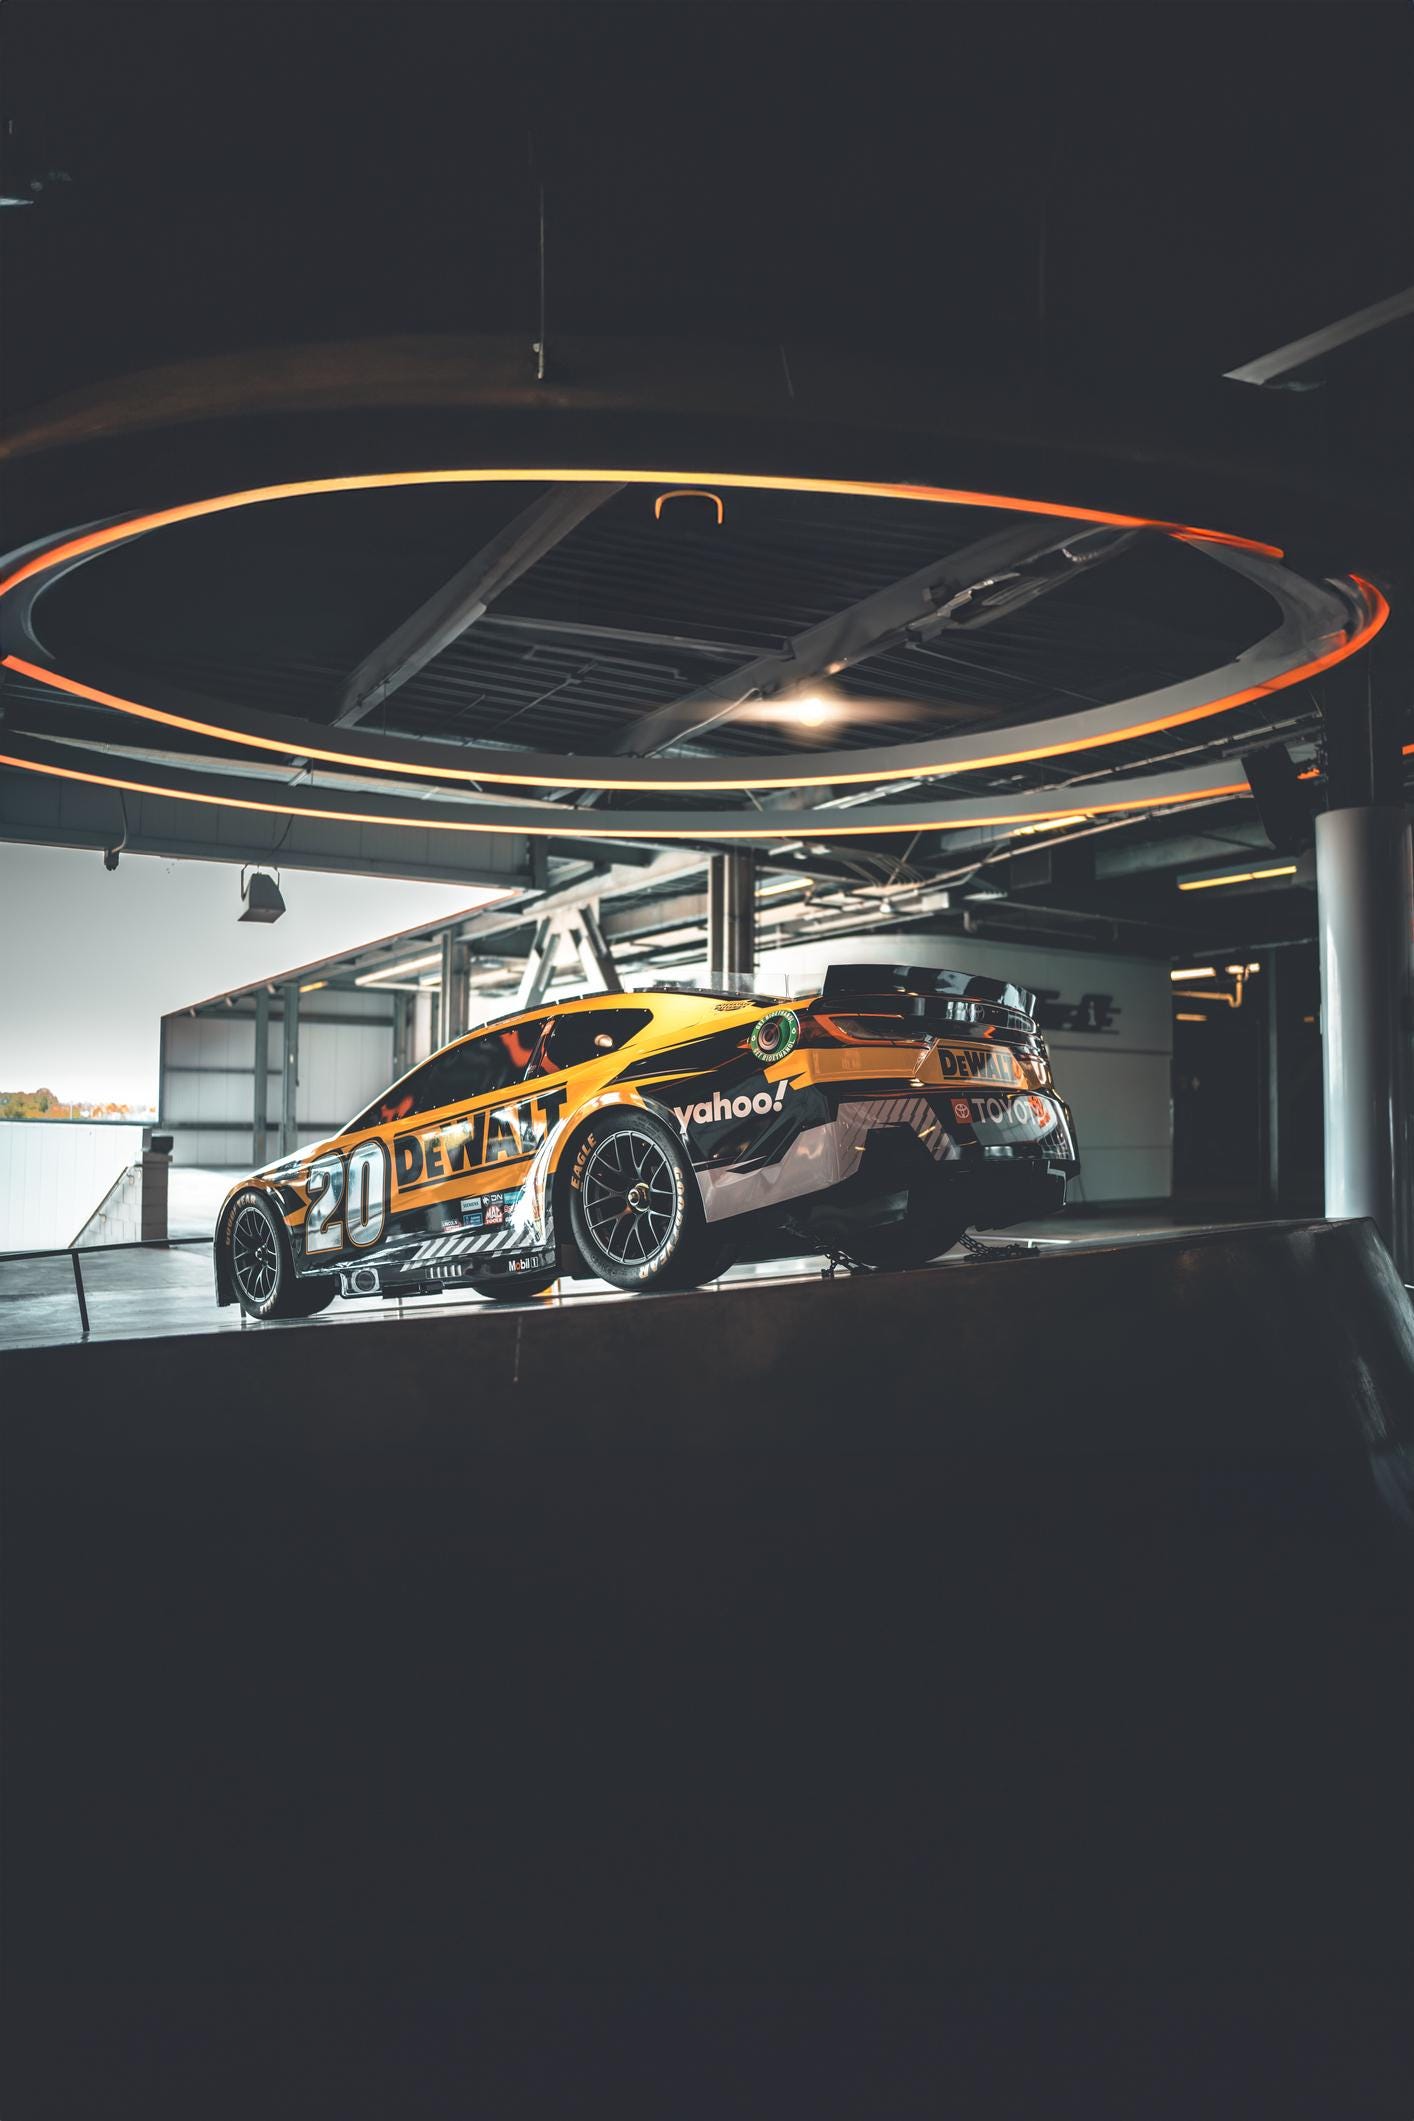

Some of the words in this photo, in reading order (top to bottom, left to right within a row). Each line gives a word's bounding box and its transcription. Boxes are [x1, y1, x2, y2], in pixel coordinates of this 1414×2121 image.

[674, 1079, 788, 1134] yahoo!
[570, 1131, 597, 1191] EAGLE
[306, 1138, 390, 1255] 20
[509, 1258, 530, 1273] Mobil
